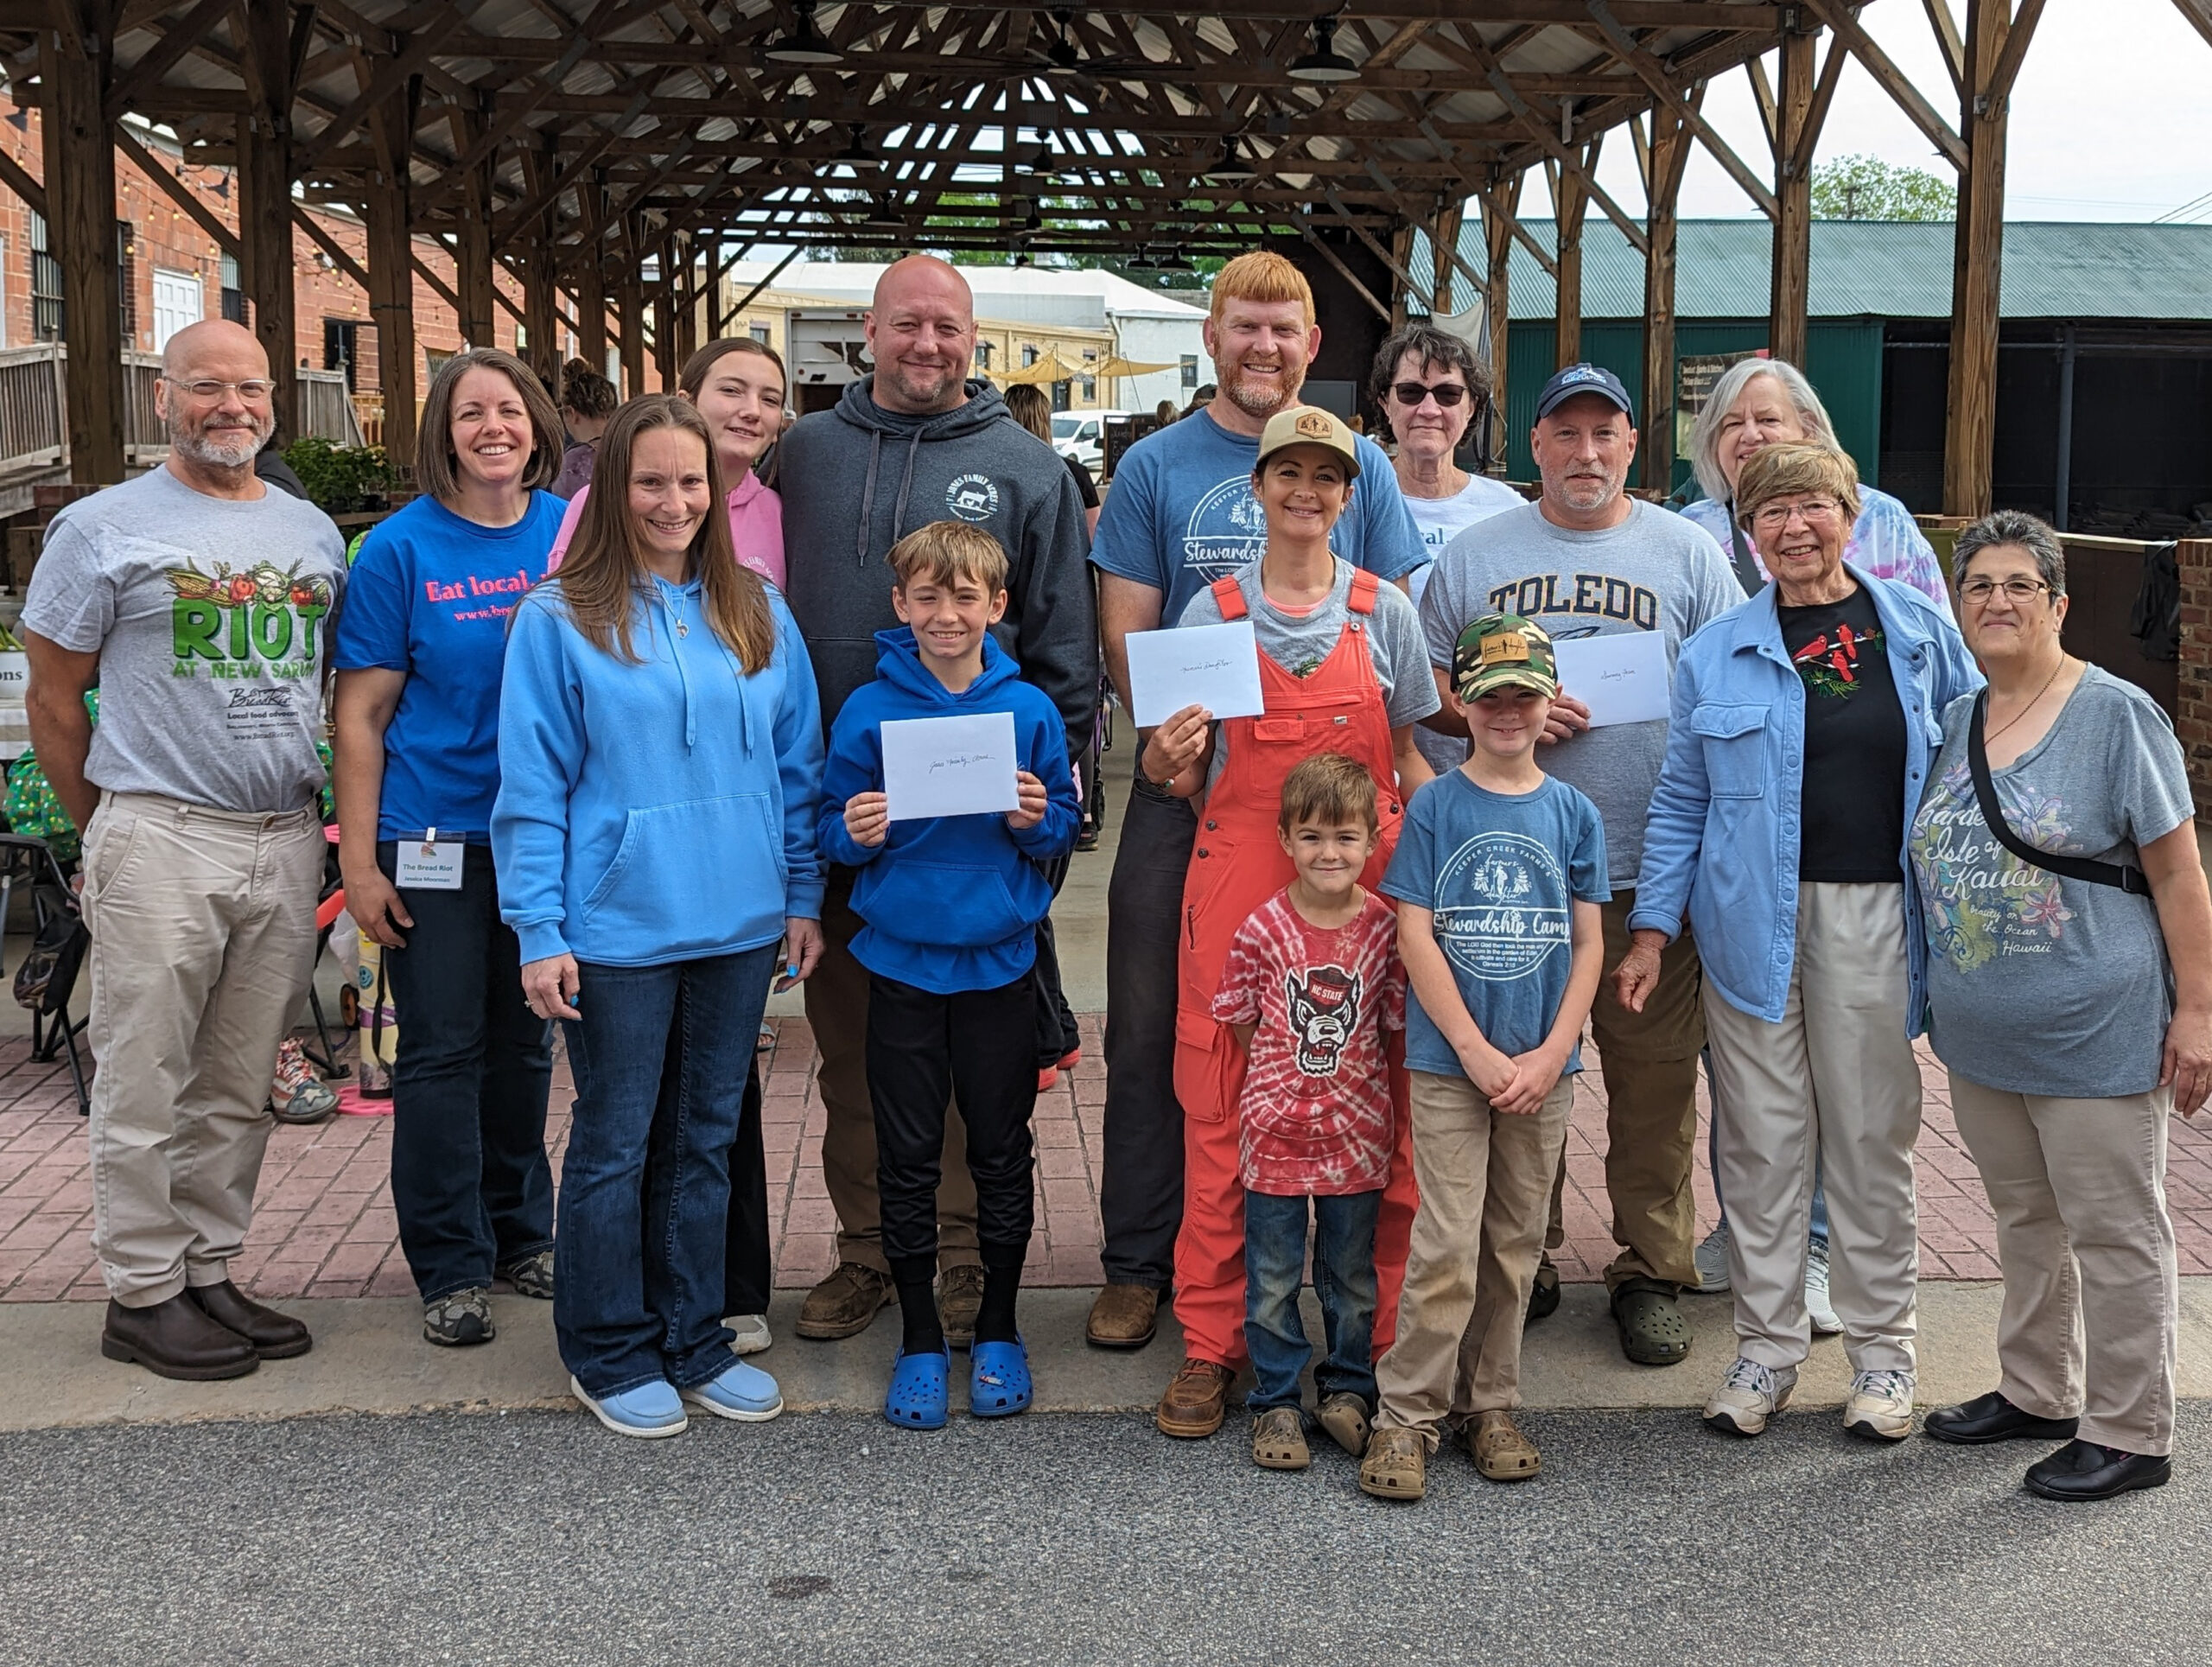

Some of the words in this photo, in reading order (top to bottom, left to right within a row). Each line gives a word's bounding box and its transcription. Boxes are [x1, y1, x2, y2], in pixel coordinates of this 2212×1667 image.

[1420, 527, 1450, 545] al.
[1184, 540, 1268, 562] Stewardsh
[424, 580, 467, 602] Eat
[467, 569, 535, 596] local.
[1489, 575, 1658, 631] TOLEDO
[173, 598, 330, 661] RIOT
[172, 661, 199, 678] AT
[210, 661, 261, 679] NEW
[1913, 787, 1987, 827] Garde
[1925, 826, 1981, 864] Isle
[1985, 840, 2003, 859] of
[1455, 849, 1483, 876] KEEPER
[1520, 849, 1546, 869] FARMS
[1942, 865, 2044, 900] Kauai
[1433, 910, 1528, 943] Stewardship
[1981, 919, 1999, 933] the
[2006, 912, 2018, 920] on
[2002, 940, 2053, 956] Hawaii
[1311, 983, 1322, 996] NC
[1321, 989, 1344, 1002] STATE
